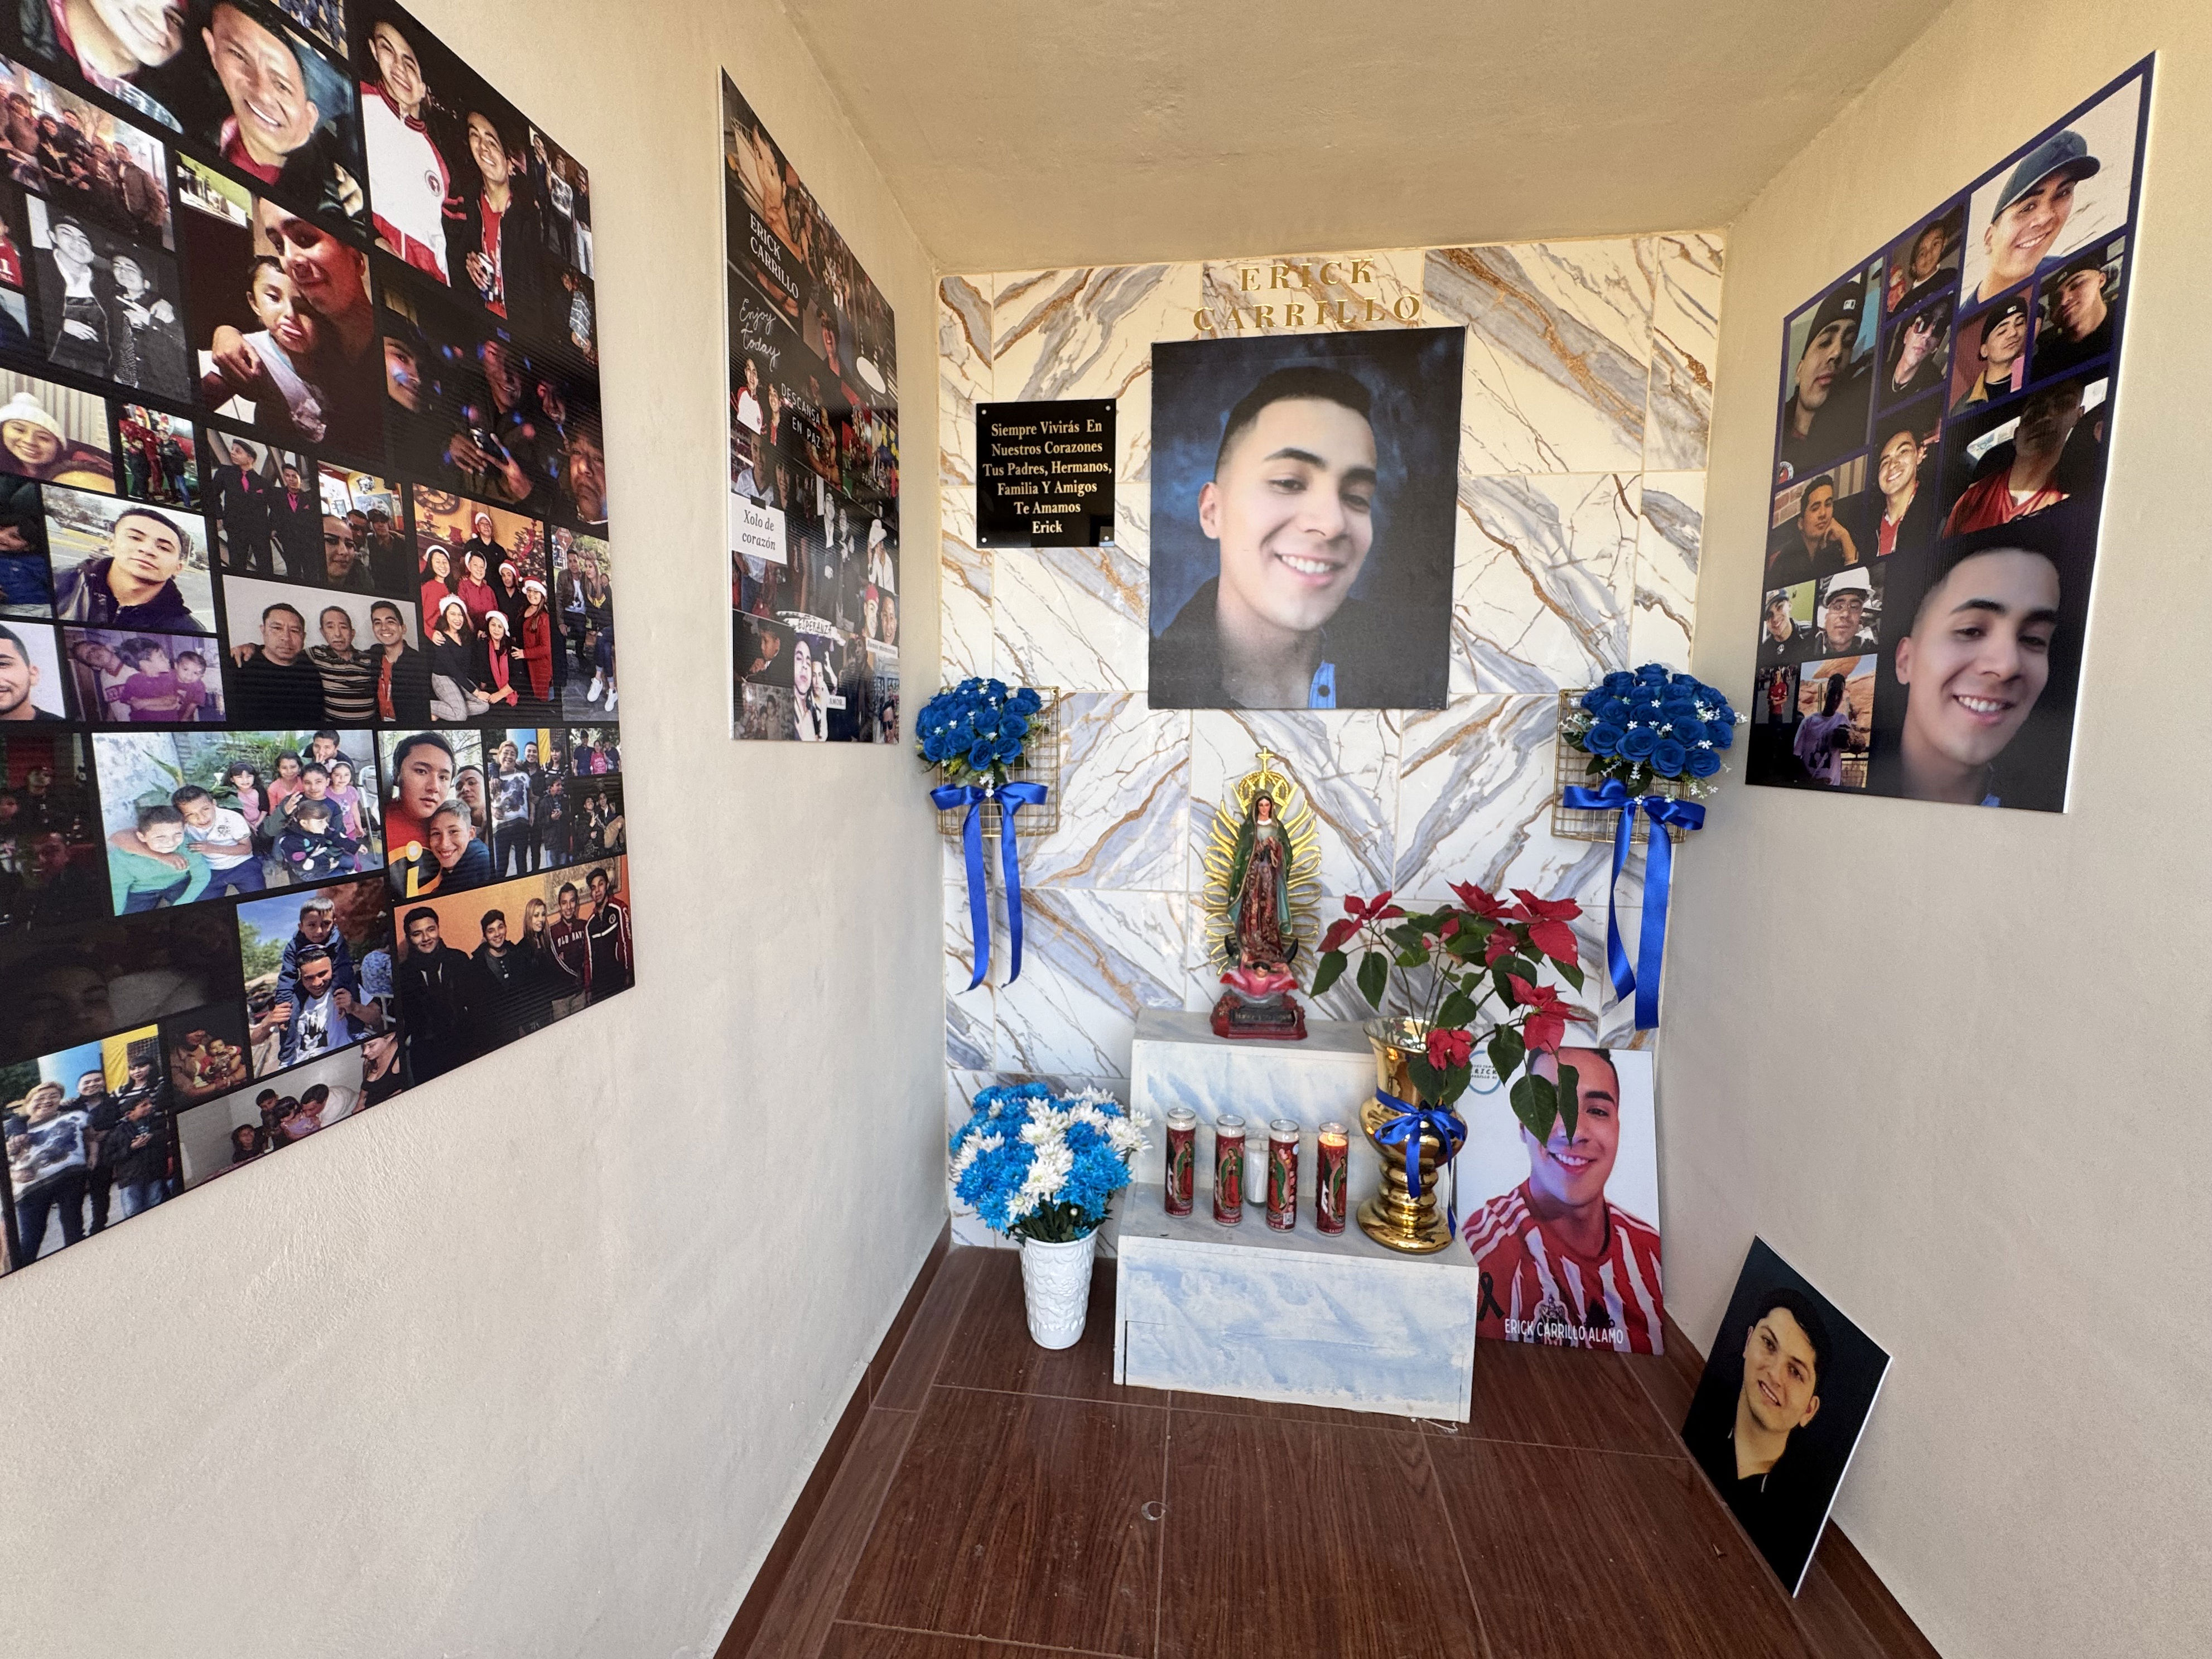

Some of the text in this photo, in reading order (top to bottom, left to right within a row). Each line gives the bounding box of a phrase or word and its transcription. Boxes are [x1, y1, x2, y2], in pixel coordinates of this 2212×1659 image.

[749, 213, 781, 261] ERICK
[750, 236, 799, 299] CARRILLO
[1239, 258, 1375, 291] ERICK
[740, 298, 777, 335] Enjoy
[1193, 295, 1420, 330] CARRILLO
[741, 322, 780, 373] Today
[781, 383, 821, 426] DESCANSA
[792, 416, 821, 450] EN PAZ
[991, 419, 1102, 440] Siempre Vivirás En
[991, 441, 1103, 456] Nuestros Corazones
[982, 460, 1112, 477] Tus Padres, Hermanos,
[997, 479, 1097, 498] Familia Y Amigos
[1014, 501, 1081, 515] Te Amamos
[744, 509, 774, 532] Xolo de
[1032, 520, 1063, 534] Erick
[742, 532, 775, 550] corazón
[558, 935, 569, 947] OLD
[1505, 1318, 1623, 1344] ERICK CARRILLO ALAMO
